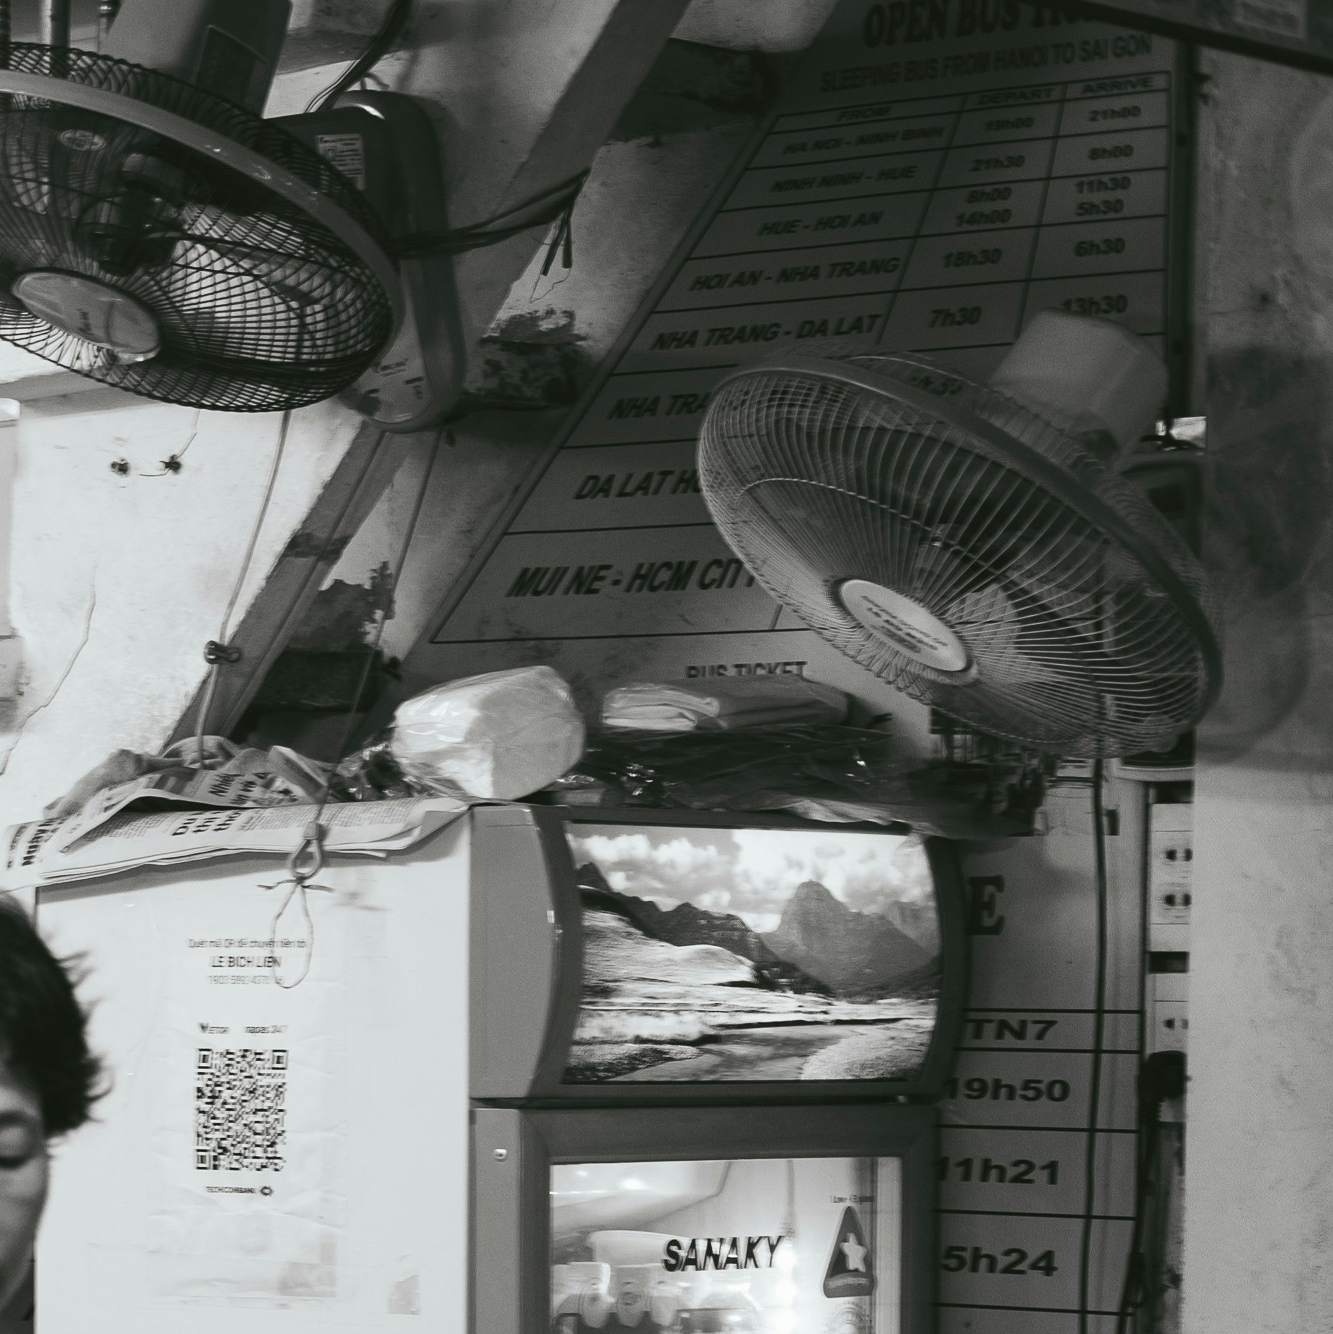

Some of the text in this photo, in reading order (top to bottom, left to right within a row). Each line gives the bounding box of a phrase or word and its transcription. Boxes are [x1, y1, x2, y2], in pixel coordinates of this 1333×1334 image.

[863, 2, 946, 48] OPEN
[956, 0, 1020, 38] BUS
[820, 61, 900, 93] SLEEPING
[902, 58, 940, 82] BUS
[943, 53, 991, 79] FROM
[1051, 42, 1077, 67] TO
[1079, 39, 1109, 63] SAI
[978, 87, 1056, 105] DEPART
[1084, 77, 1155, 94] ARRIVE
[836, 106, 892, 122] FROM
[1088, 105, 1143, 122] 21h00
[855, 131, 900, 147] NINH
[969, 154, 1027, 172] 21h30
[770, 174, 816, 193] NINH
[817, 171, 862, 190] NINH
[875, 165, 919, 183] HUE
[1076, 175, 1132, 194] 11h30
[954, 207, 1013, 228] 14h00
[1074, 198, 1125, 217] 5h30
[757, 218, 802, 237] HUE
[813, 213, 851, 232] HOI
[848, 209, 885, 228] AN
[941, 246, 1004, 270] 18h30
[1073, 236, 1127, 258] 6h30
[689, 271, 732, 293] HOI
[731, 267, 765, 289] AN
[774, 263, 821, 285] NHA
[824, 256, 903, 280] TRANG
[928, 304, 983, 329] 7h30
[652, 329, 700, 351] NHA
[702, 321, 781, 345] TRANG
[795, 316, 834, 340] DA
[832, 313, 885, 336] LAT
[606, 398, 661, 421] NHA
[575, 474, 616, 500] DA
[616, 470, 676, 498] LAT
[505, 565, 565, 599] MUI
[564, 563, 614, 596] NE
[624, 560, 695, 595] HCM
[697, 556, 765, 592] CITY
[965, 1018, 1059, 1041] TN7
[944, 1077, 1071, 1103] 19h50
[935, 1156, 1060, 1186] 11h21
[663, 1235, 787, 1273] SANAKY
